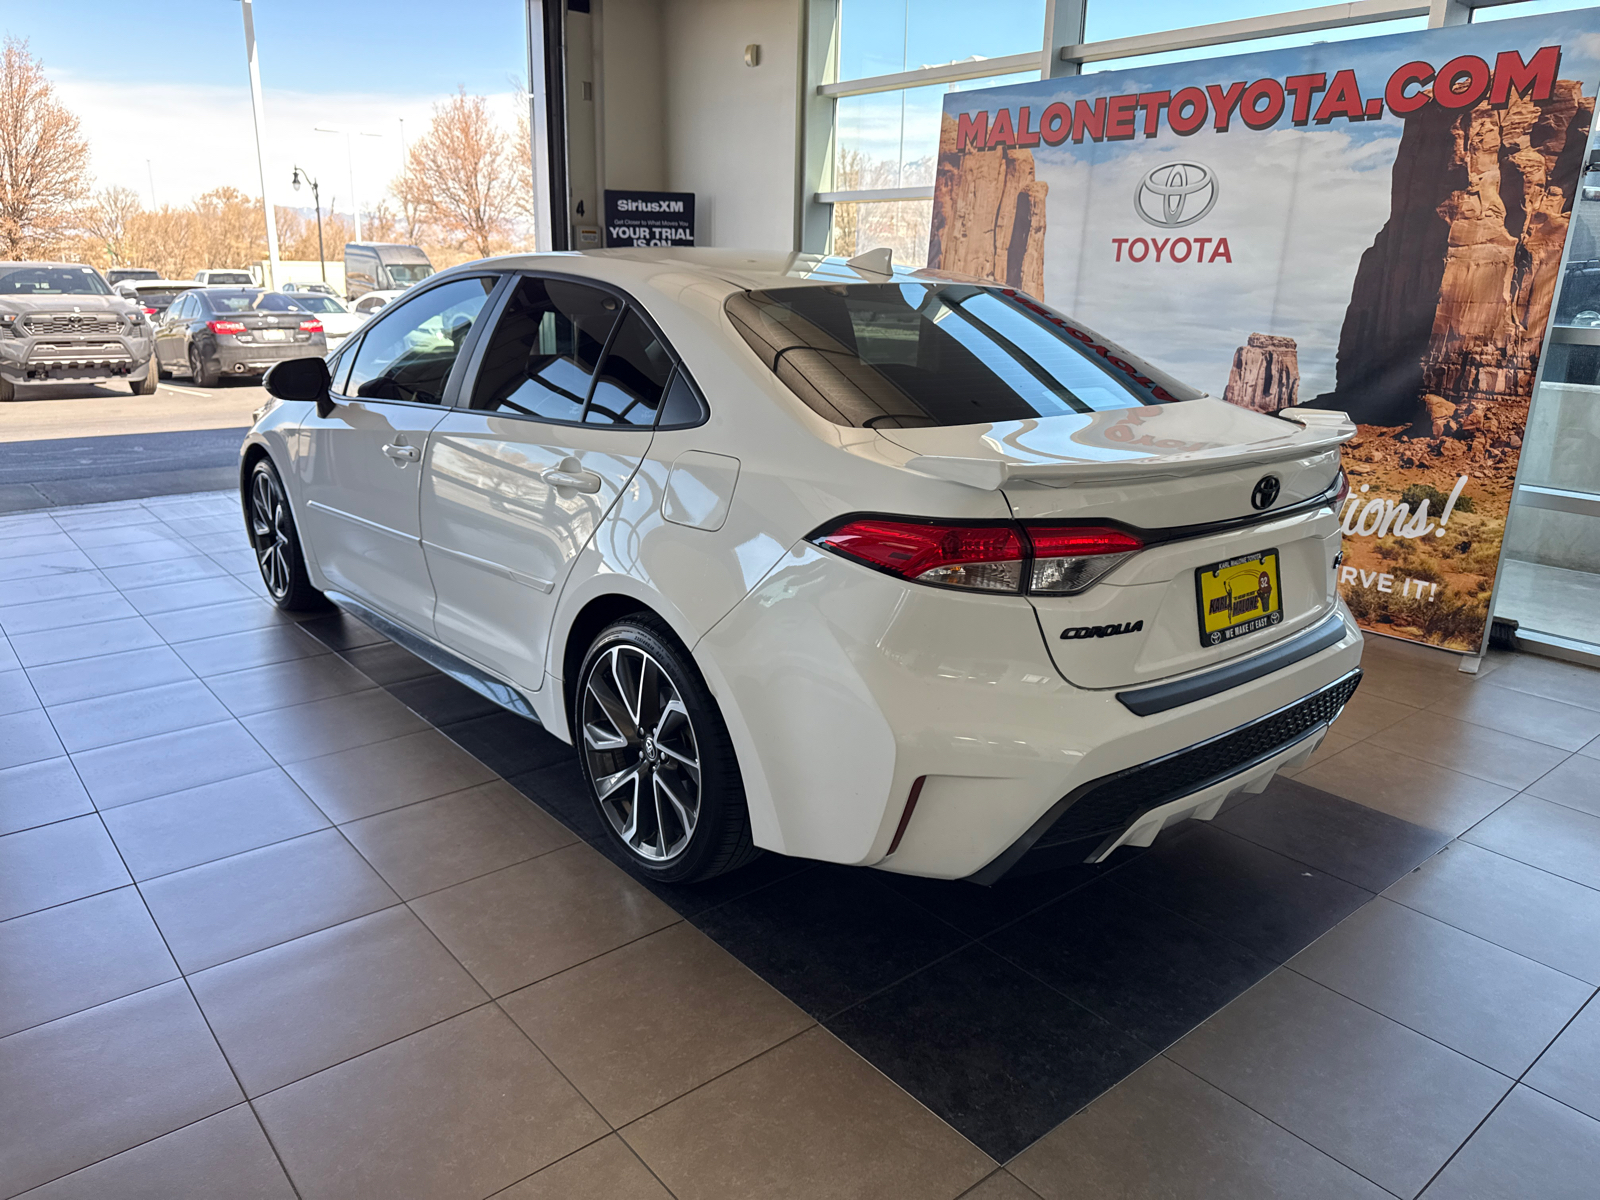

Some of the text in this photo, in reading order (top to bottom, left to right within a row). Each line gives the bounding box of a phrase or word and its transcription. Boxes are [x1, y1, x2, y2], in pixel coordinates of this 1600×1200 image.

[956, 45, 1562, 152] MALONETOYOTA.COM
[576, 199, 585, 218] 4
[617, 199, 684, 213] SiriusXM
[609, 226, 650, 239] YOUR
[652, 227, 694, 240] TRIAL
[648, 219, 661, 227] What
[679, 220, 689, 228] You
[633, 239, 671, 247] IS ON
[1111, 237, 1233, 264] TOYOTA
[1260, 576, 1268, 588] 32
[1340, 565, 1437, 602] RVE IT!
[1060, 620, 1144, 639] COROLLA
[1224, 617, 1268, 639] WE MAKE IT EASY
